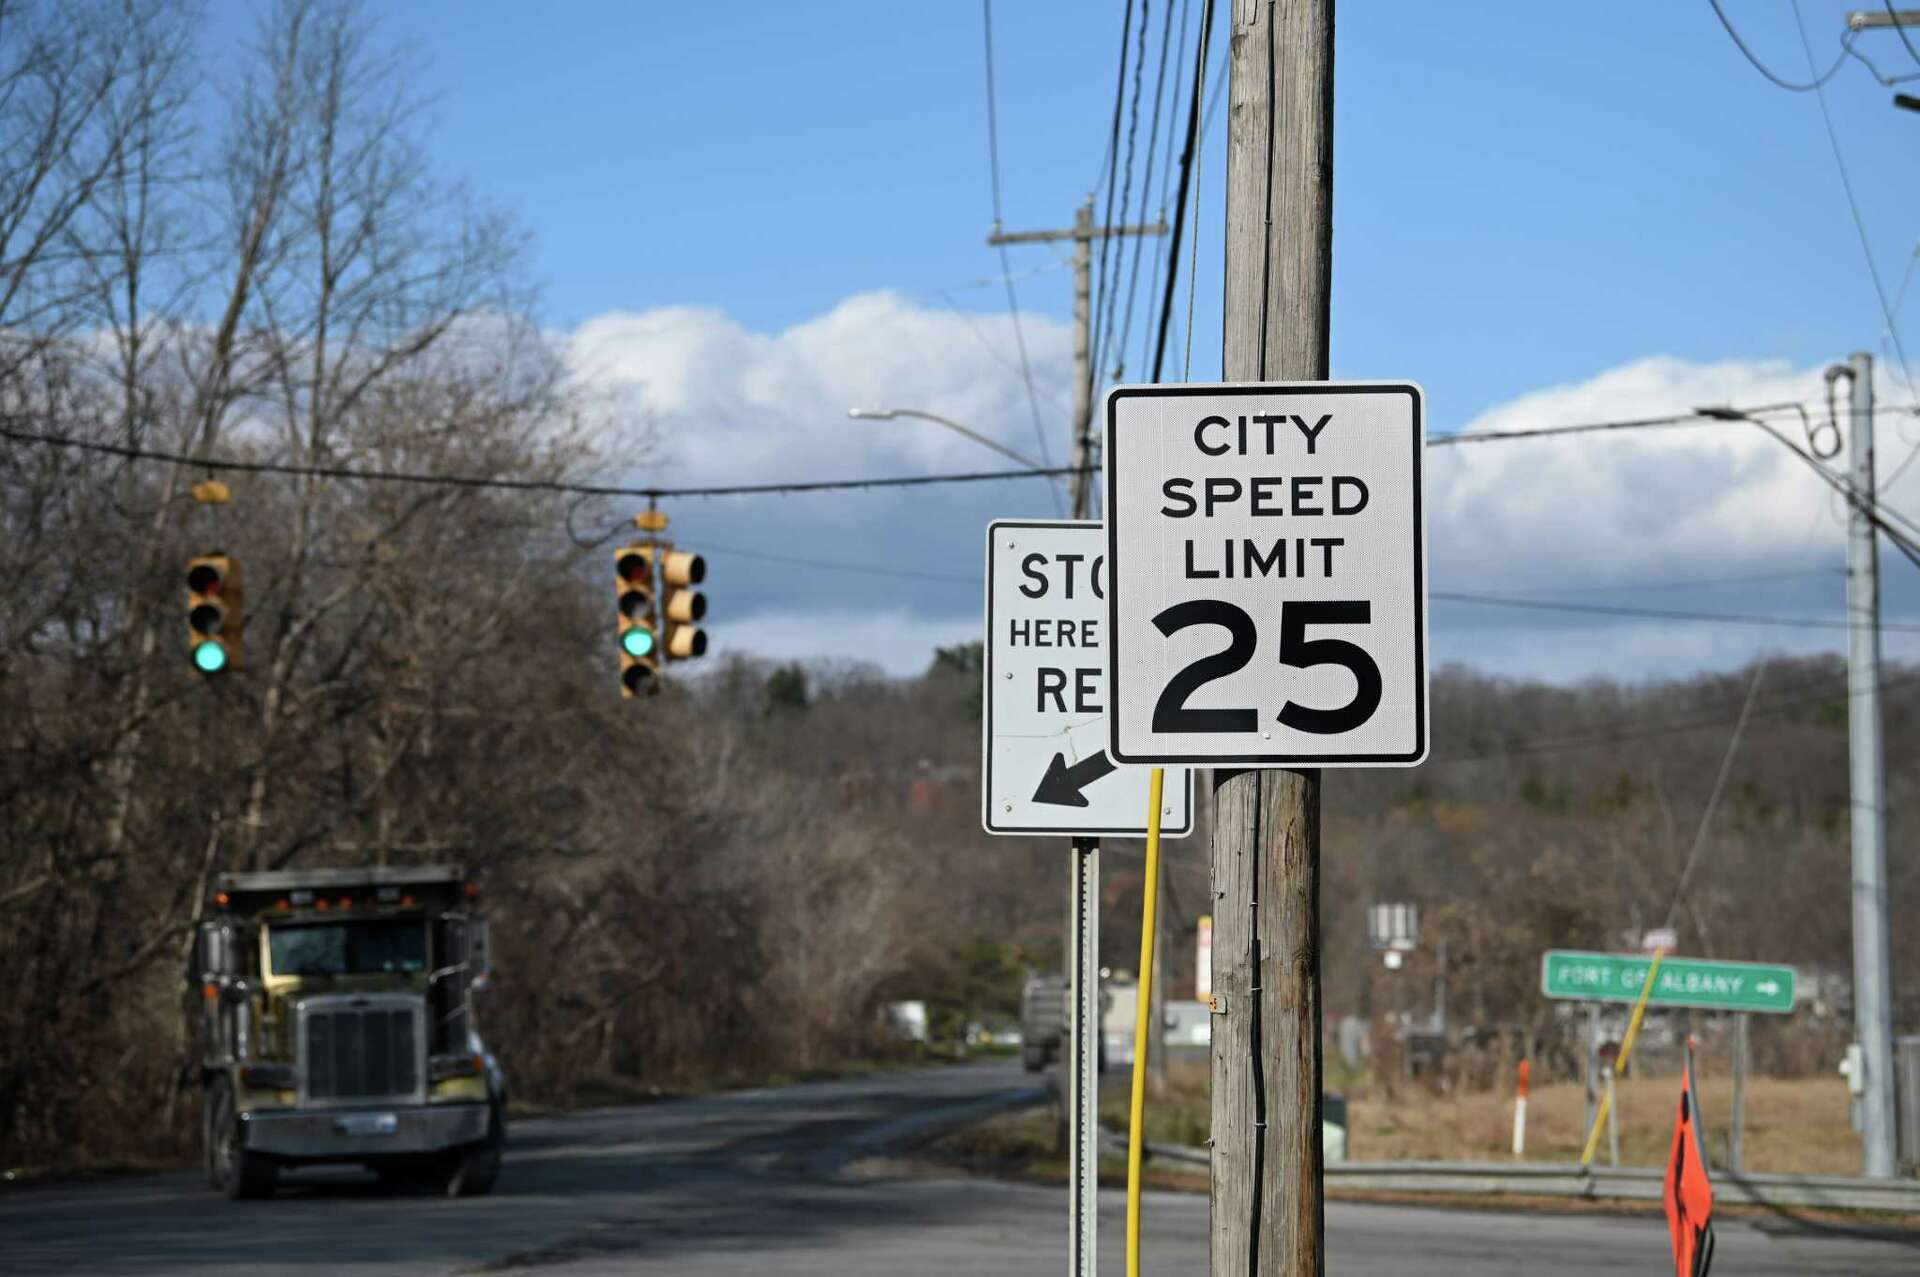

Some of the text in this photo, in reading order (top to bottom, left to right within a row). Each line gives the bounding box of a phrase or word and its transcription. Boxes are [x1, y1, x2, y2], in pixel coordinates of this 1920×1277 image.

[1193, 414, 1333, 456] CITY
[1160, 476, 1370, 518] SPEED
[1018, 552, 1104, 600] ST
[1185, 537, 1345, 579] LIMIT
[1009, 618, 1099, 648] HERE
[1150, 599, 1383, 735] 25
[1037, 667, 1103, 713] RE
[1659, 970, 1745, 995] ALBANY
